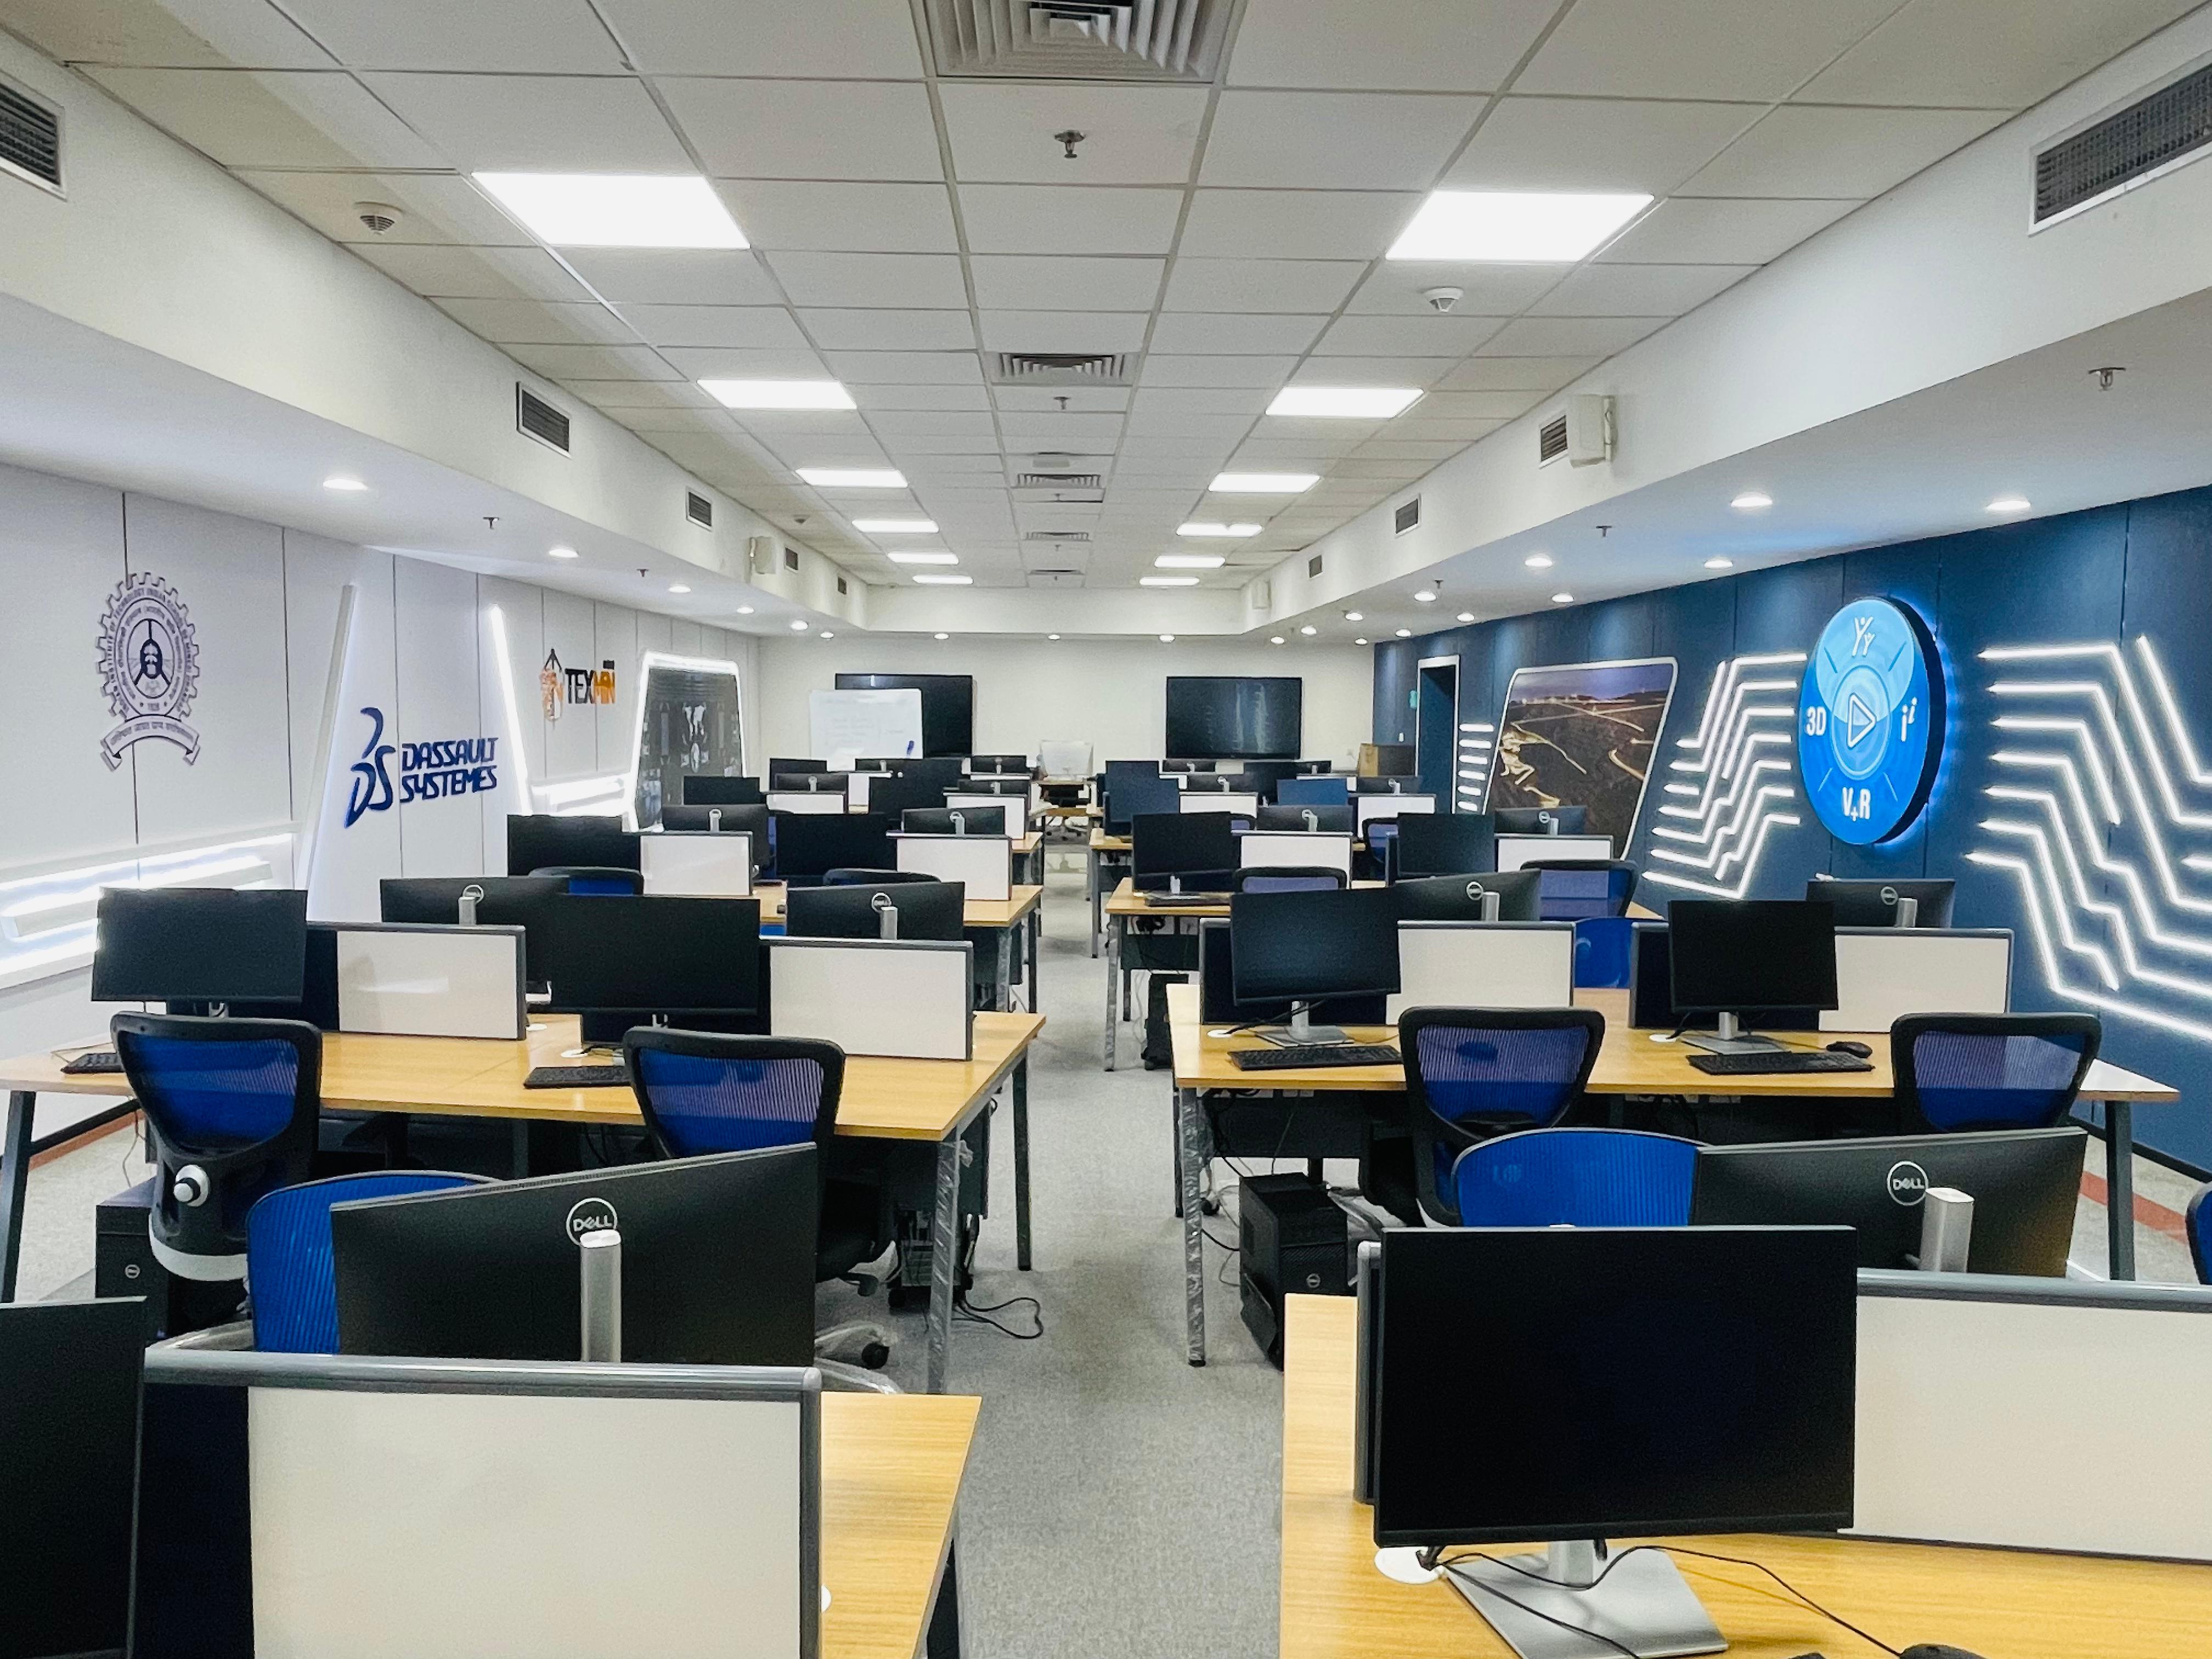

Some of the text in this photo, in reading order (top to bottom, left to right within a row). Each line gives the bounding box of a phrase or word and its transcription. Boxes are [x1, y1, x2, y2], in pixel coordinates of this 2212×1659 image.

[1806, 706, 1826, 736] 3D
[402, 737, 499, 771] DASSAULT
[400, 765, 498, 803] SYSTEMES
[1893, 1177, 1925, 1190] DELL
[573, 1215, 613, 1232] DELL
